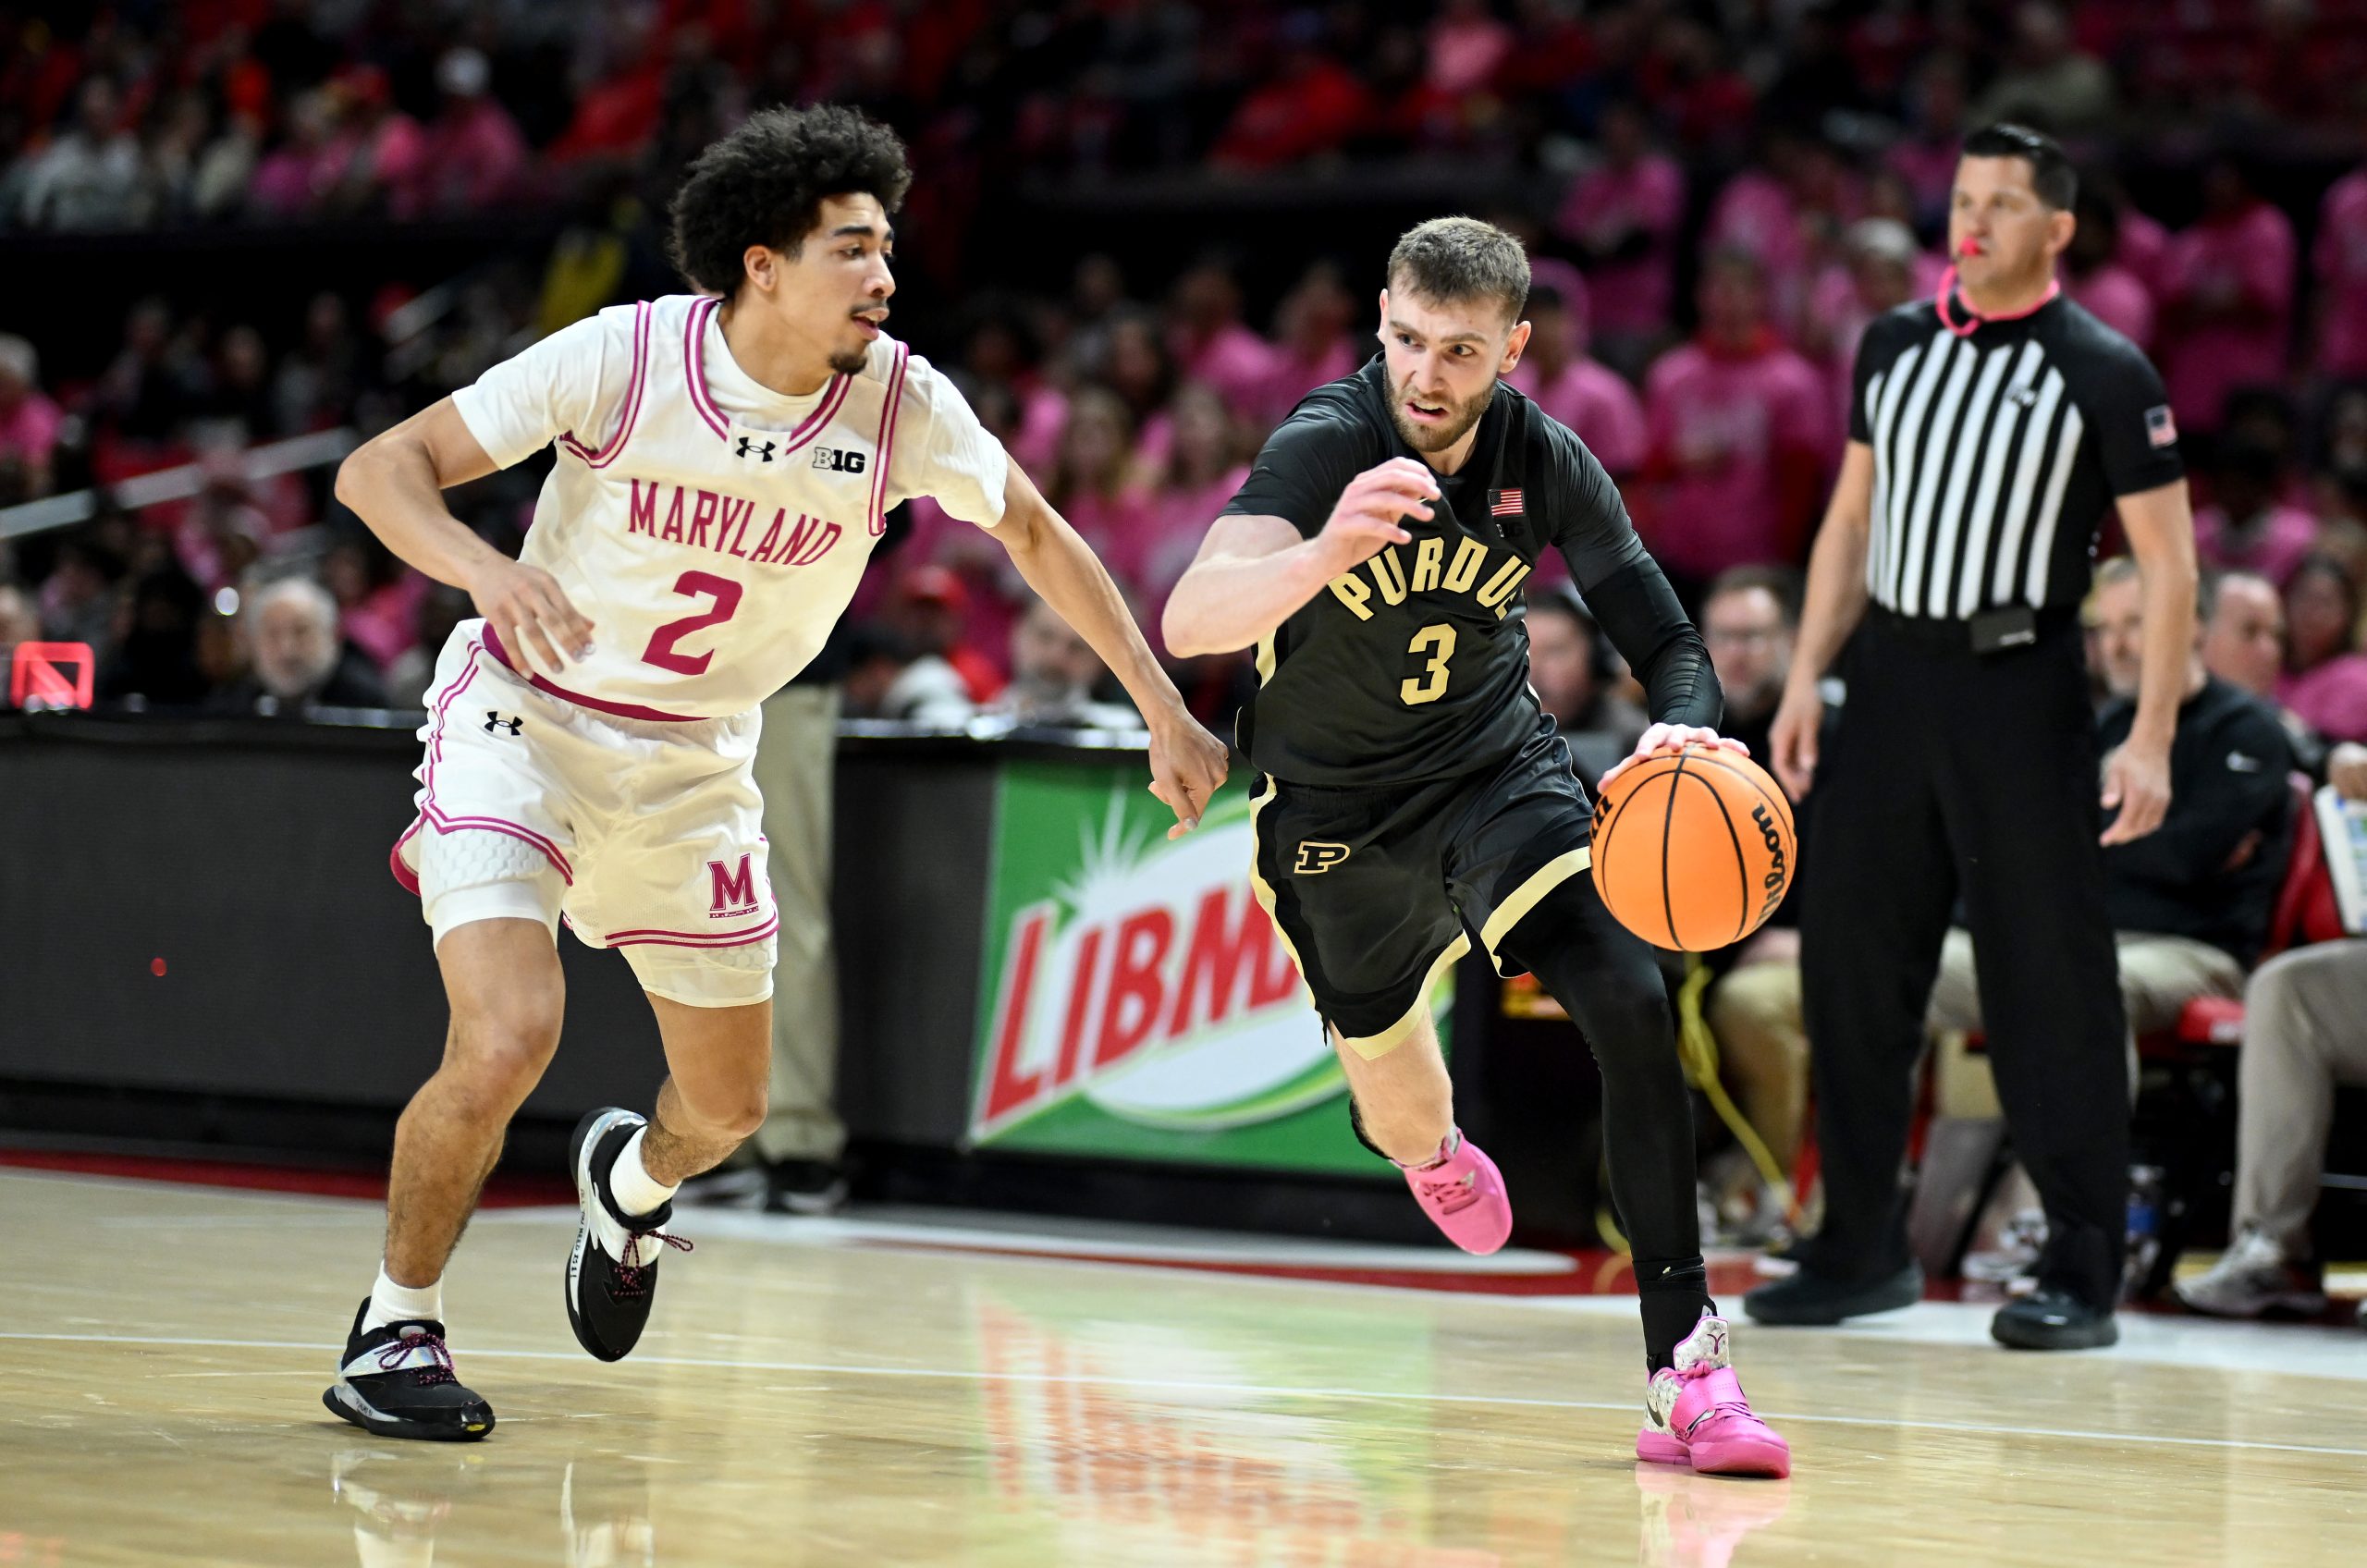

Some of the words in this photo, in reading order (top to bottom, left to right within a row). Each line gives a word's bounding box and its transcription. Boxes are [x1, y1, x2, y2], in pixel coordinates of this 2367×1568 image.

[628, 477, 842, 567] MARYLAND
[640, 570, 743, 676] 2
[1400, 622, 1457, 705] 3
[706, 852, 757, 912] M
[1294, 840, 1351, 875] P
